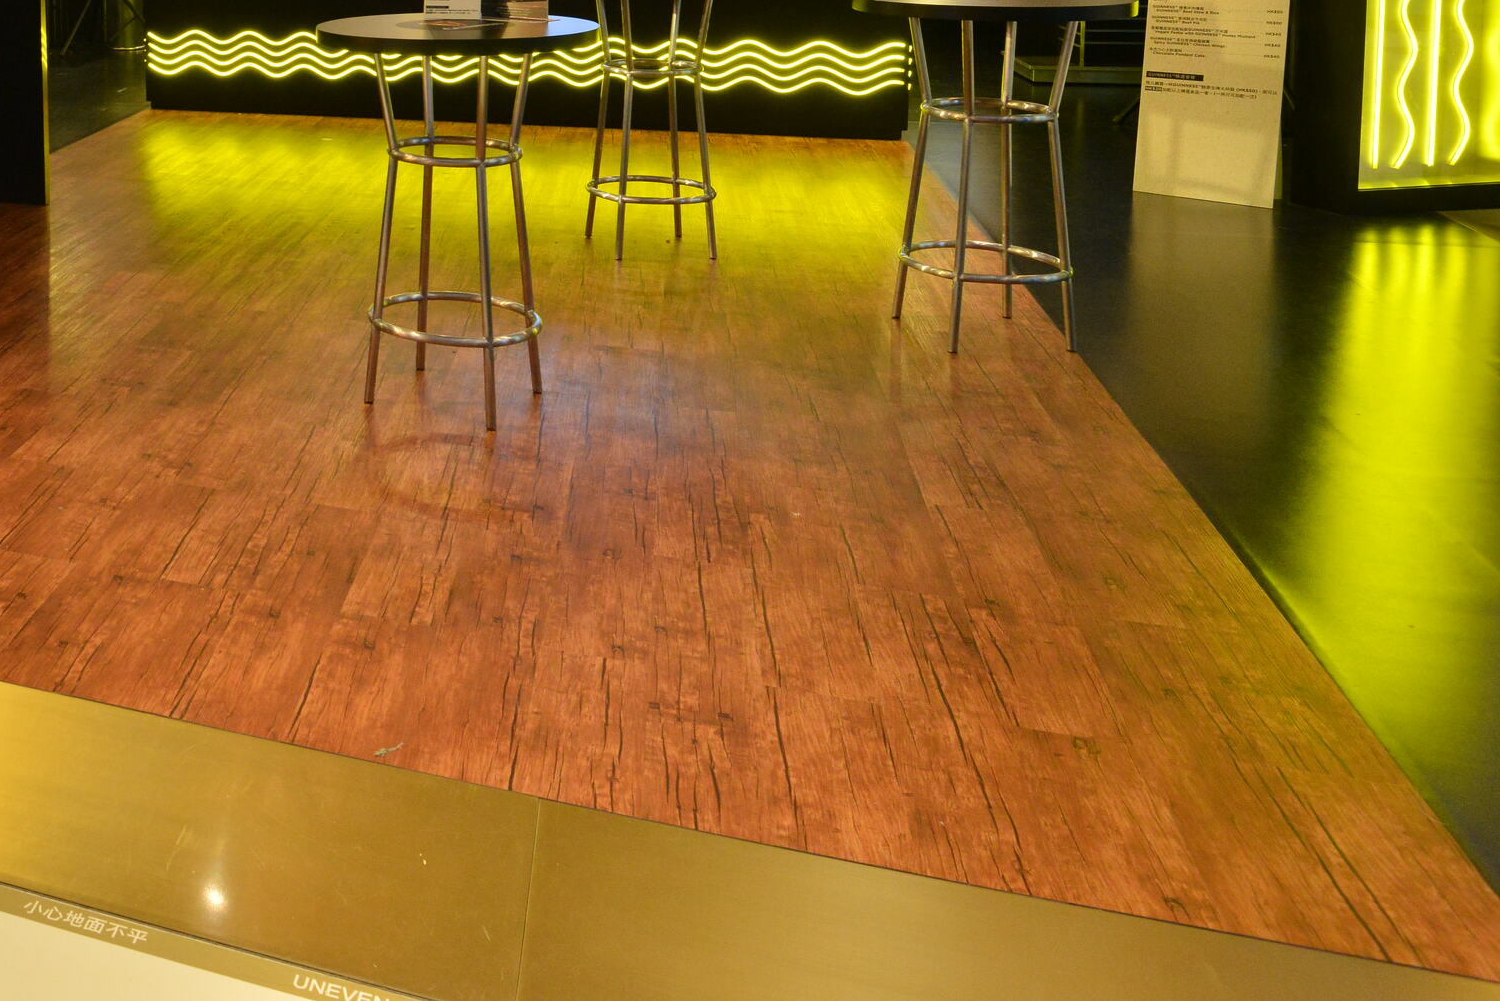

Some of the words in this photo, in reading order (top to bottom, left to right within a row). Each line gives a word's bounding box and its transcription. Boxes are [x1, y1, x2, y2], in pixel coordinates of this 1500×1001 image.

[24, 899, 148, 945] 小心地面不平
